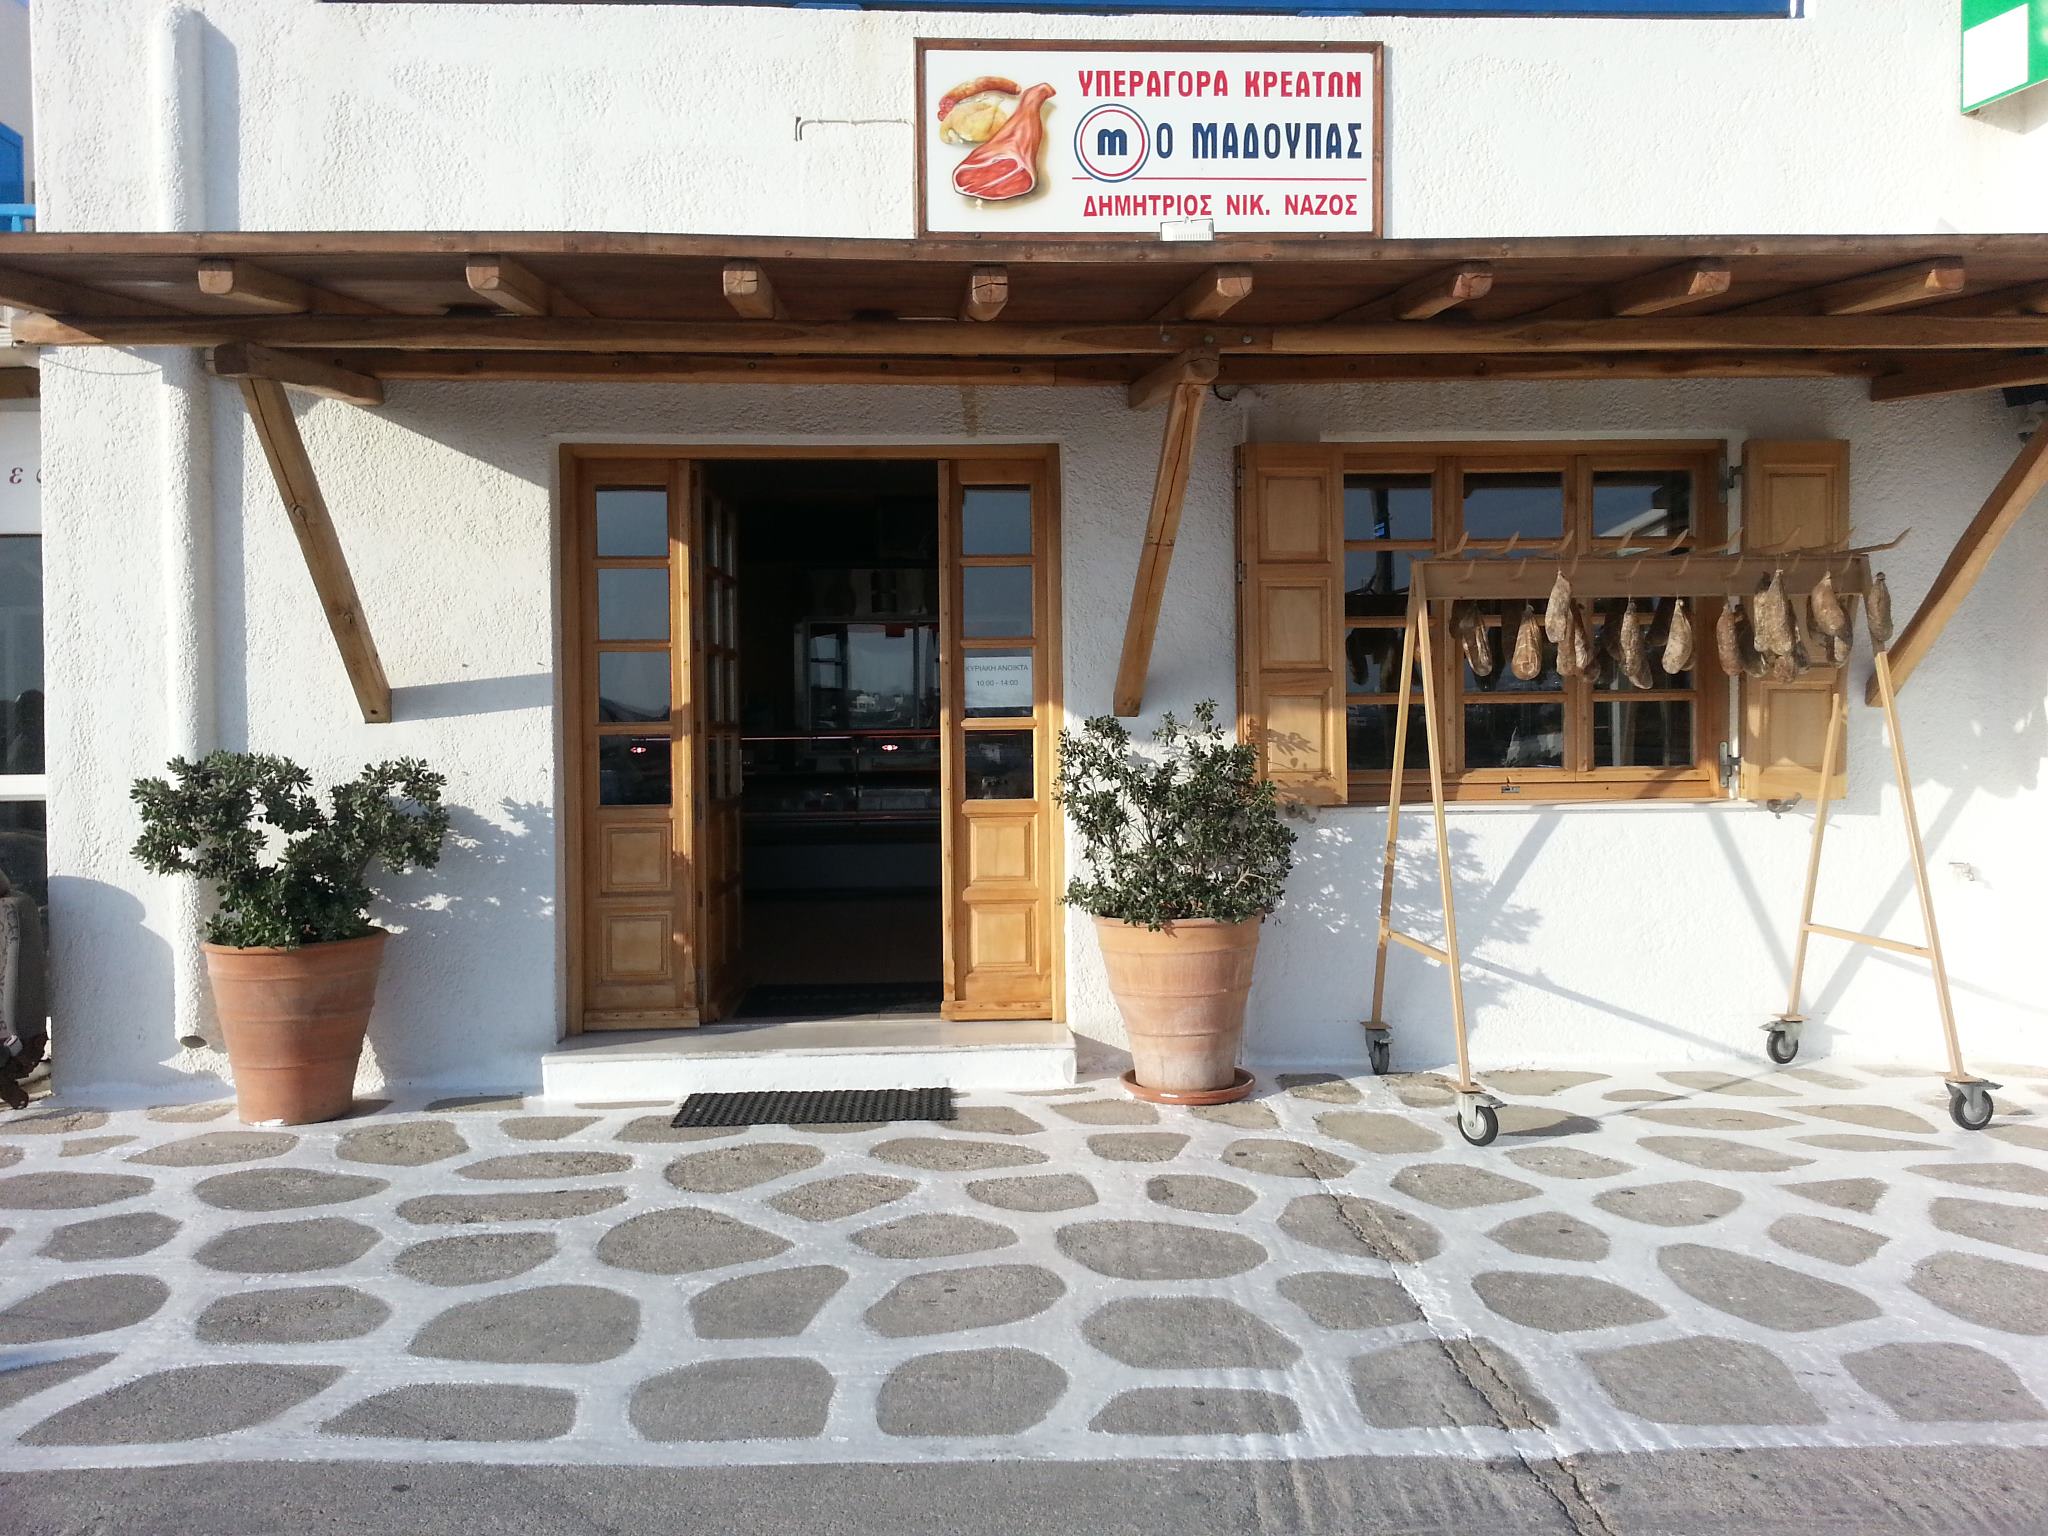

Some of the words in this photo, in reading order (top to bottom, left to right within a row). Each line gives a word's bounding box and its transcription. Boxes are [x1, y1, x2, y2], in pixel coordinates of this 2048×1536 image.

[1078, 70, 1228, 97] ΥΠΕΡΑΓΟΡΑ
[1244, 71, 1362, 98] ΚΡΕΑΤΩΝ
[1192, 122, 1362, 159] ΜΑΔΟΥΠΑΣ
[1083, 194, 1212, 217] ΔΗΜΗΤΡΙΟΣ
[1226, 194, 1270, 216] ΝΙΚ.
[1284, 194, 1358, 217] ΝΑΖΟΣ
